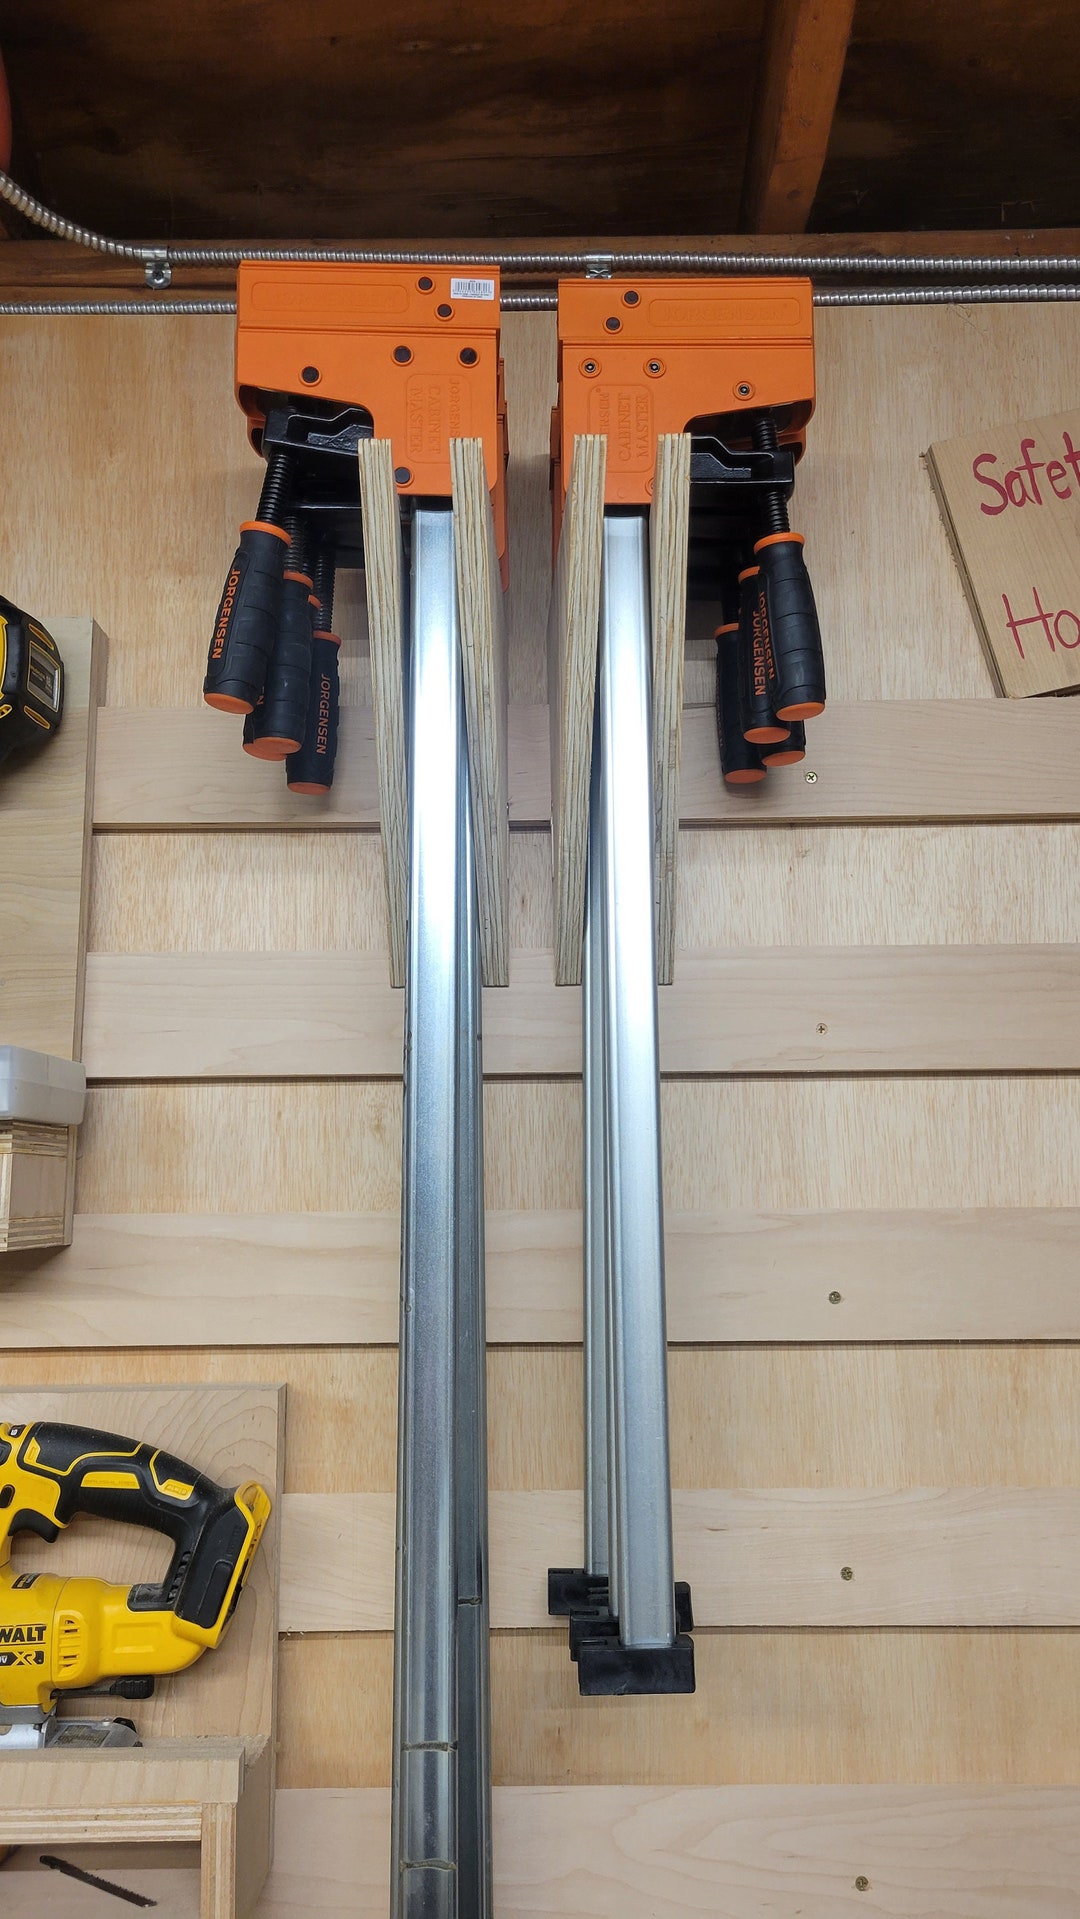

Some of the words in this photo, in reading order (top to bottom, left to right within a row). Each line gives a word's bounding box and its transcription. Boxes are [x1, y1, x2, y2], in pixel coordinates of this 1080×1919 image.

[410, 388, 423, 453] MASTER
[429, 386, 440, 454] CABINET
[618, 392, 630, 461] CABINET
[636, 394, 648, 457] MASTER
[212, 568, 241, 659] JORGENSEN
[316, 673, 331, 754] JORGENSEN
